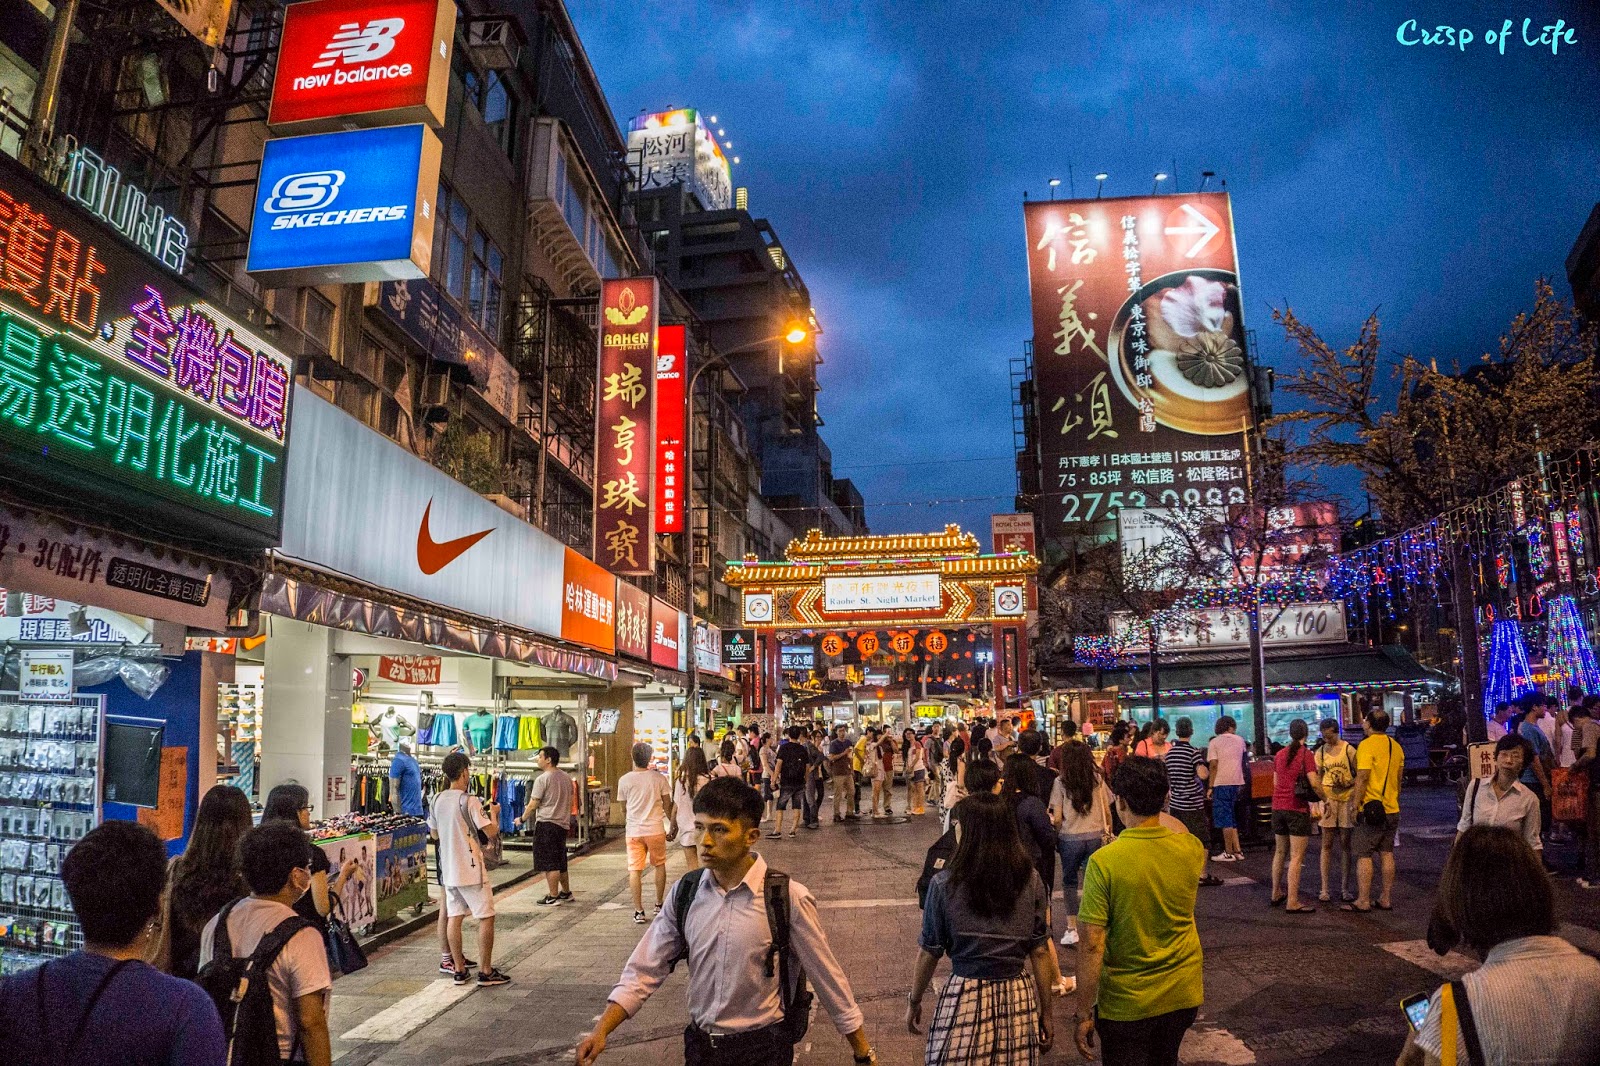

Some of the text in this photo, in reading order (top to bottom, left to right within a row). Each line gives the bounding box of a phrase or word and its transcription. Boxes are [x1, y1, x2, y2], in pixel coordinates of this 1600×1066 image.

[293, 62, 412, 90] new balance
[270, 204, 407, 231] SKECHERS
[600, 362, 648, 568] 瑞亨珠寶
[566, 582, 613, 627] 哈林運動世界
[876, 596, 899, 604] Night
[904, 595, 935, 603] Market
[1295, 610, 1327, 636] 100
[30, 664, 64, 675] 平行輸入
